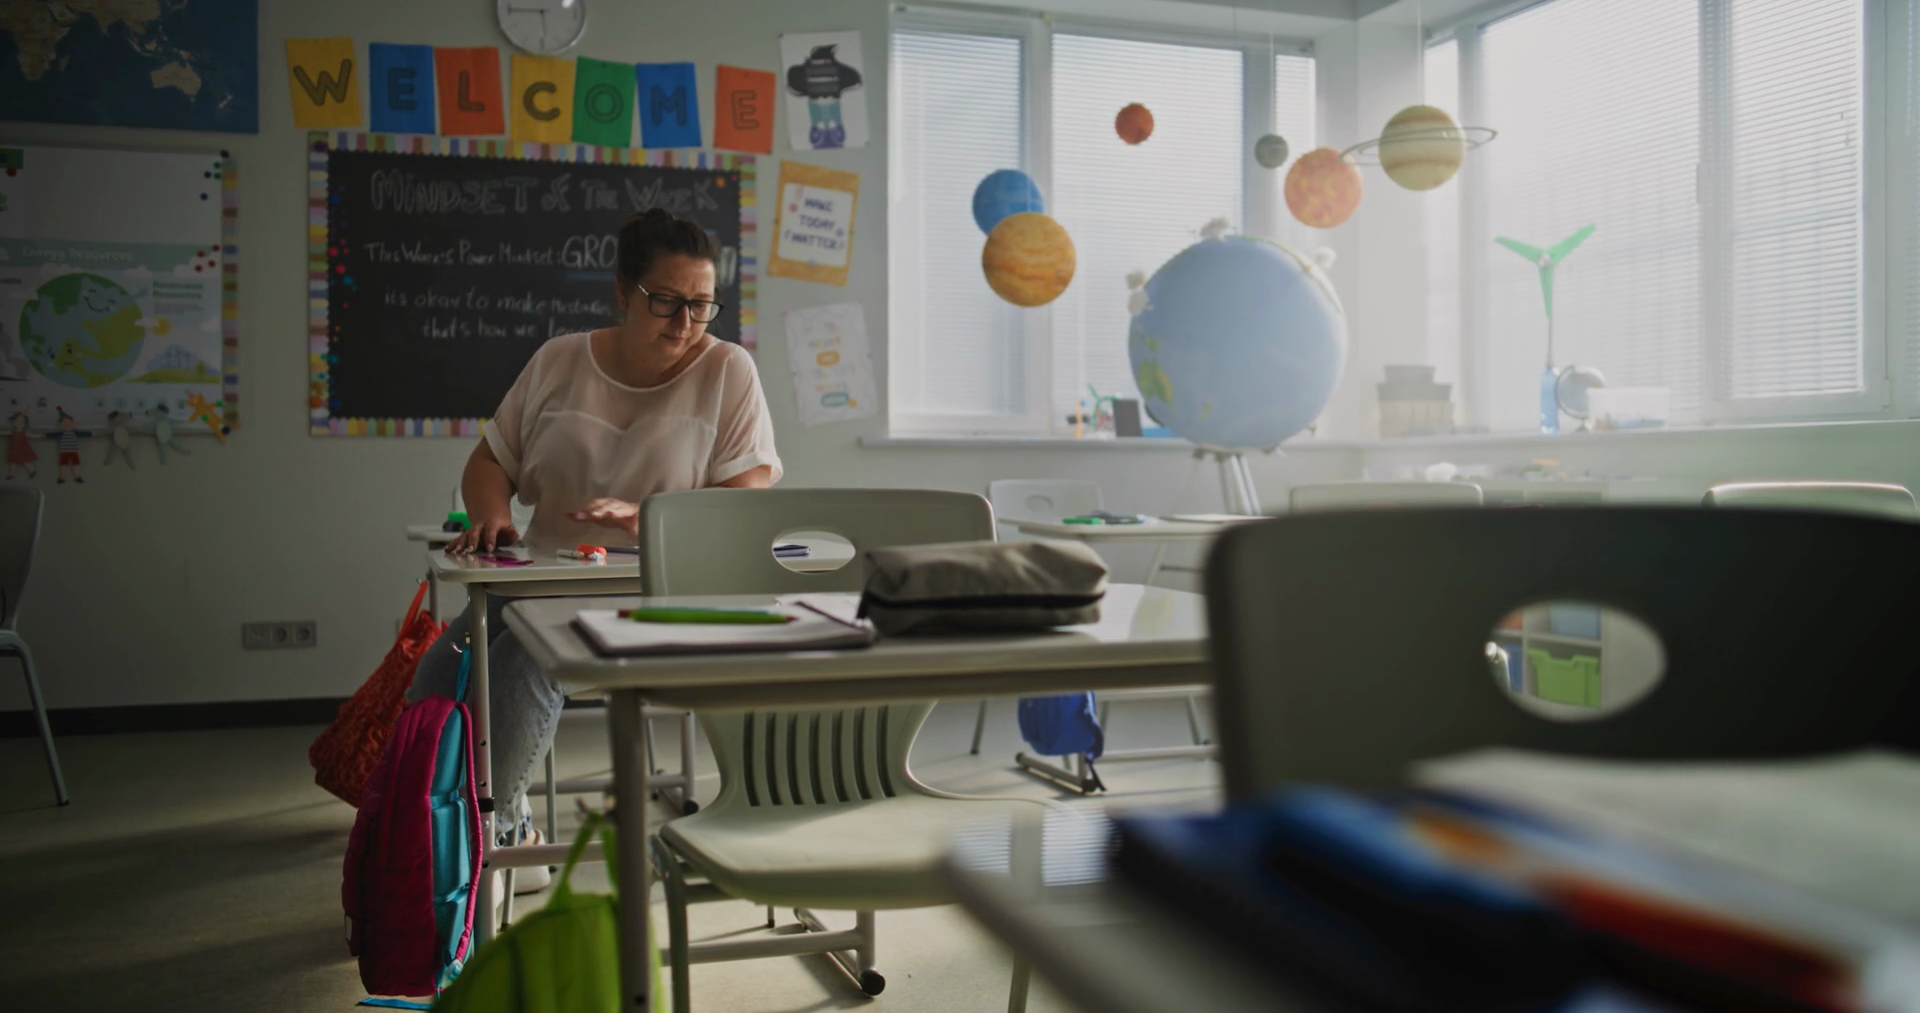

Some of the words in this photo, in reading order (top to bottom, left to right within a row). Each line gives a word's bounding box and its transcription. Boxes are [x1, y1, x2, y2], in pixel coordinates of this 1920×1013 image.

[22, 247, 66, 261] Energy
[69, 248, 133, 262] Resources
[466, 284, 489, 310] to
[497, 291, 546, 316] make
[513, 322, 538, 338] we
